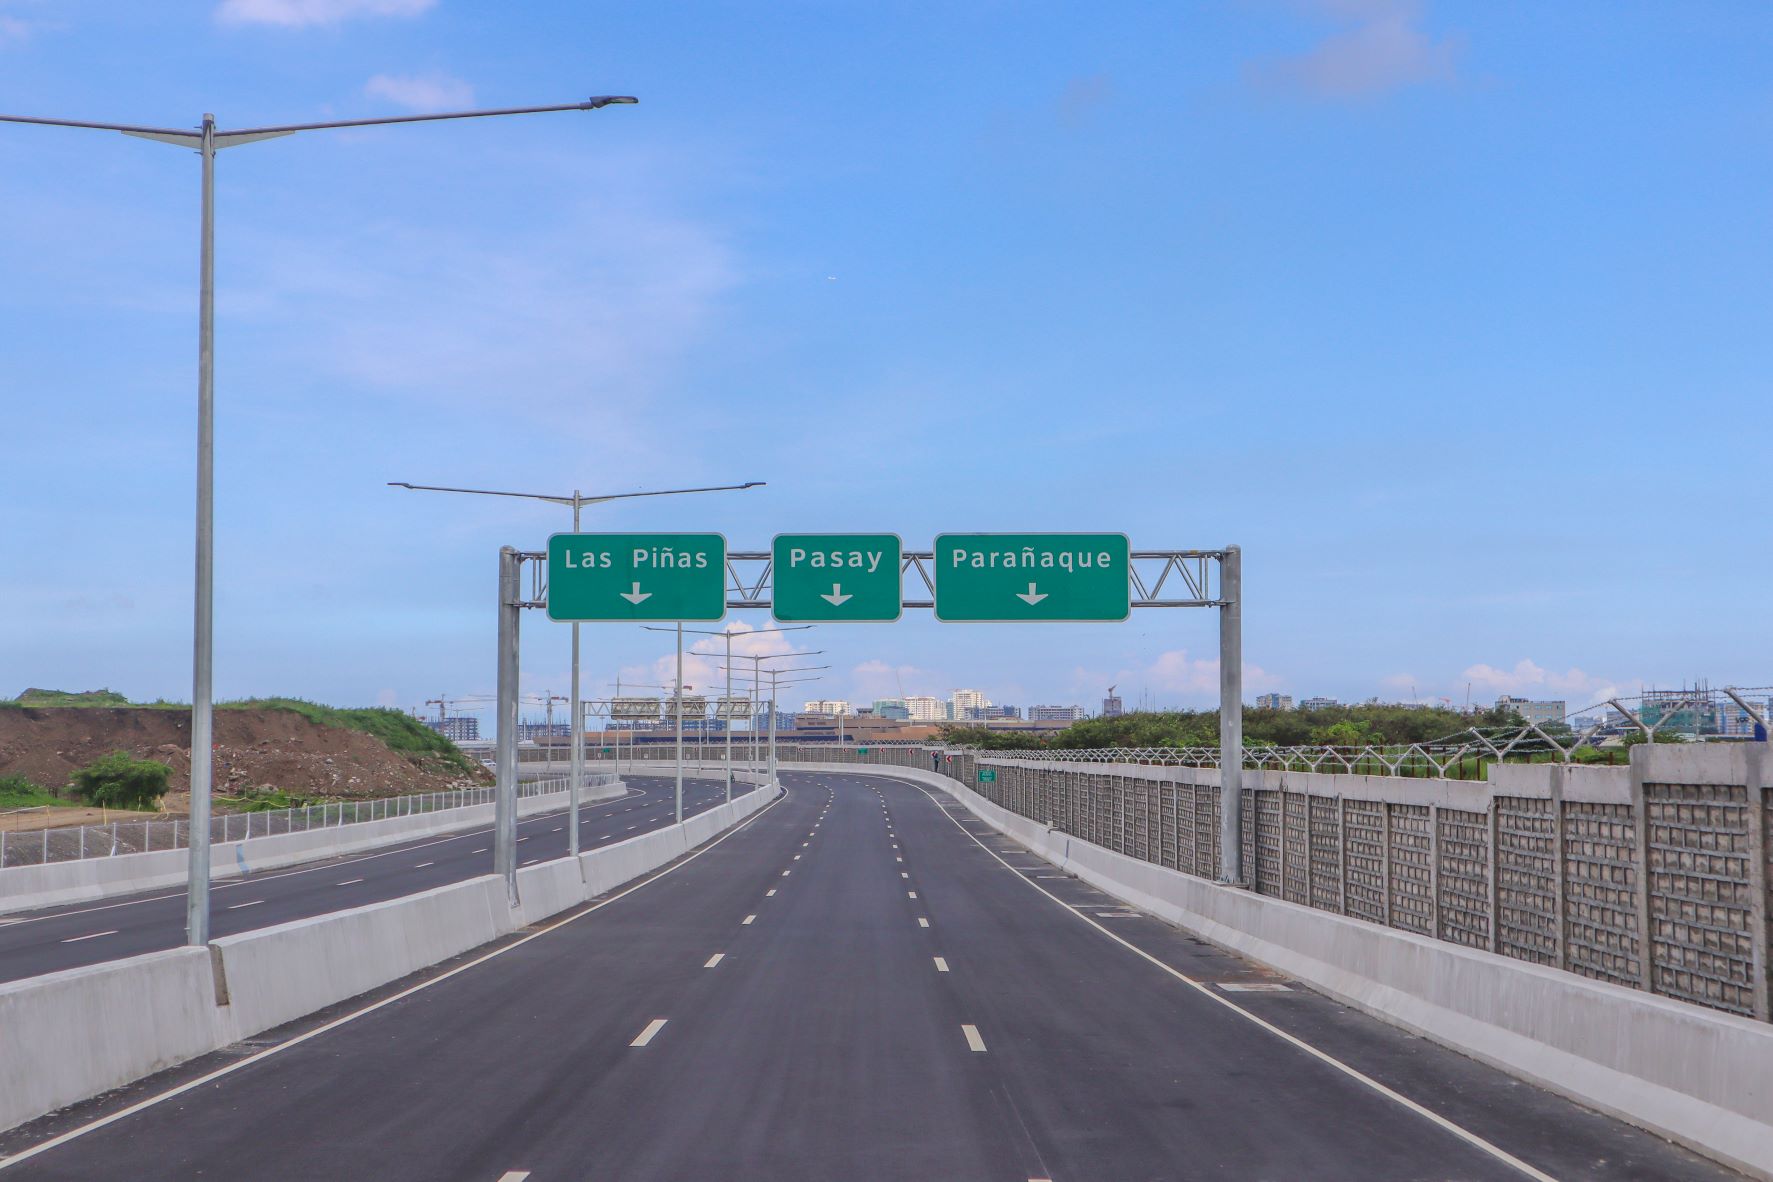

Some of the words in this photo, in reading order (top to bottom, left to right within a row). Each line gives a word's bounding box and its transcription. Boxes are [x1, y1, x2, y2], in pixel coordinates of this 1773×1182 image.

[565, 549, 612, 568] Las
[633, 547, 707, 568] Piñas
[790, 548, 882, 573] Pasay
[953, 546, 1111, 573] Parañaque
